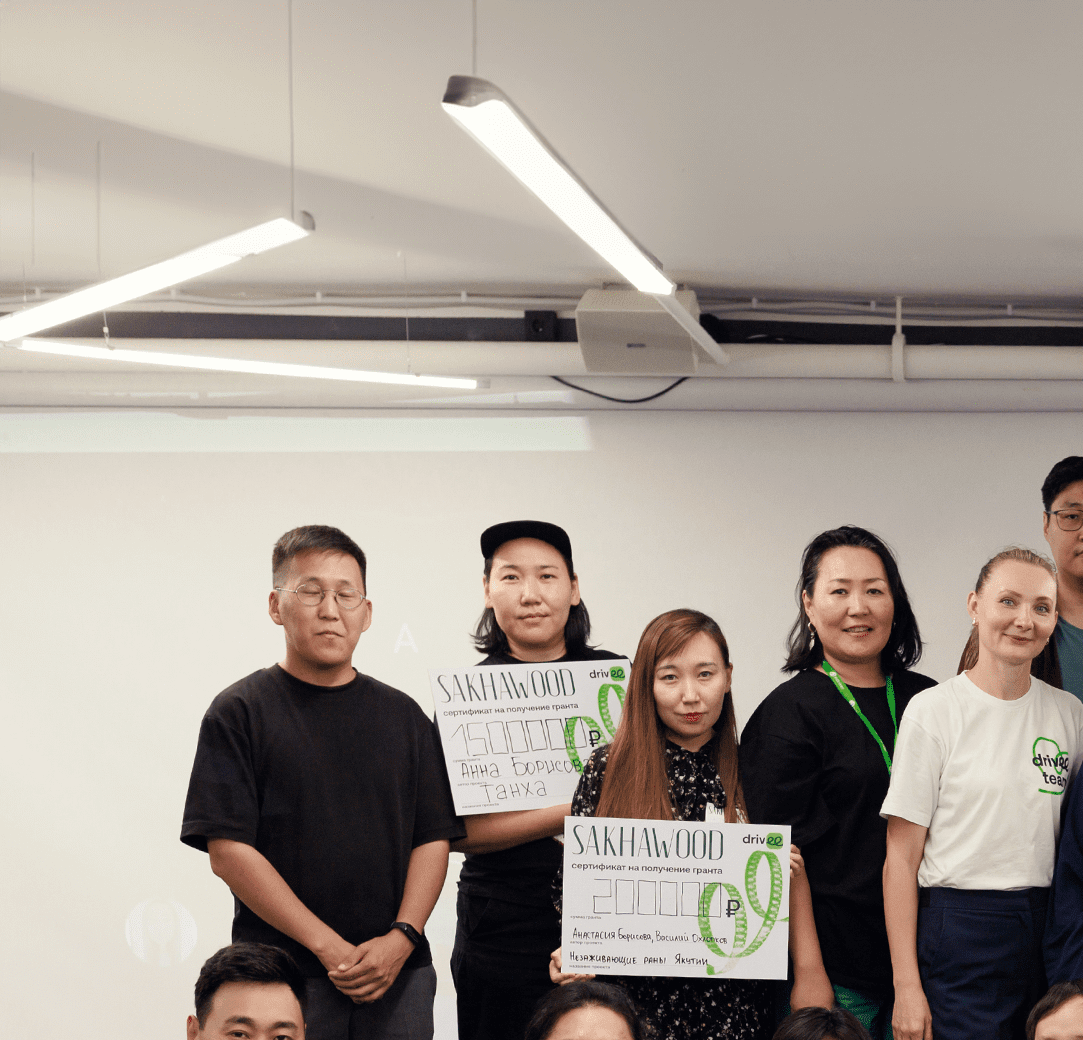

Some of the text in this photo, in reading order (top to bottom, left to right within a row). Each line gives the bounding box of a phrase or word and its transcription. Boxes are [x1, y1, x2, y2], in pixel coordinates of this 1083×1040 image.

[589, 668, 625, 679] drivee
[437, 669, 576, 703] SAKHAWOOD
[443, 707, 492, 717] сертификат
[506, 704, 550, 713] получение
[552, 703, 578, 711] гранта
[572, 825, 723, 860] SAKHAWOOD
[742, 834, 783, 846] drivee
[572, 863, 723, 875] сертификат на получение гранта
